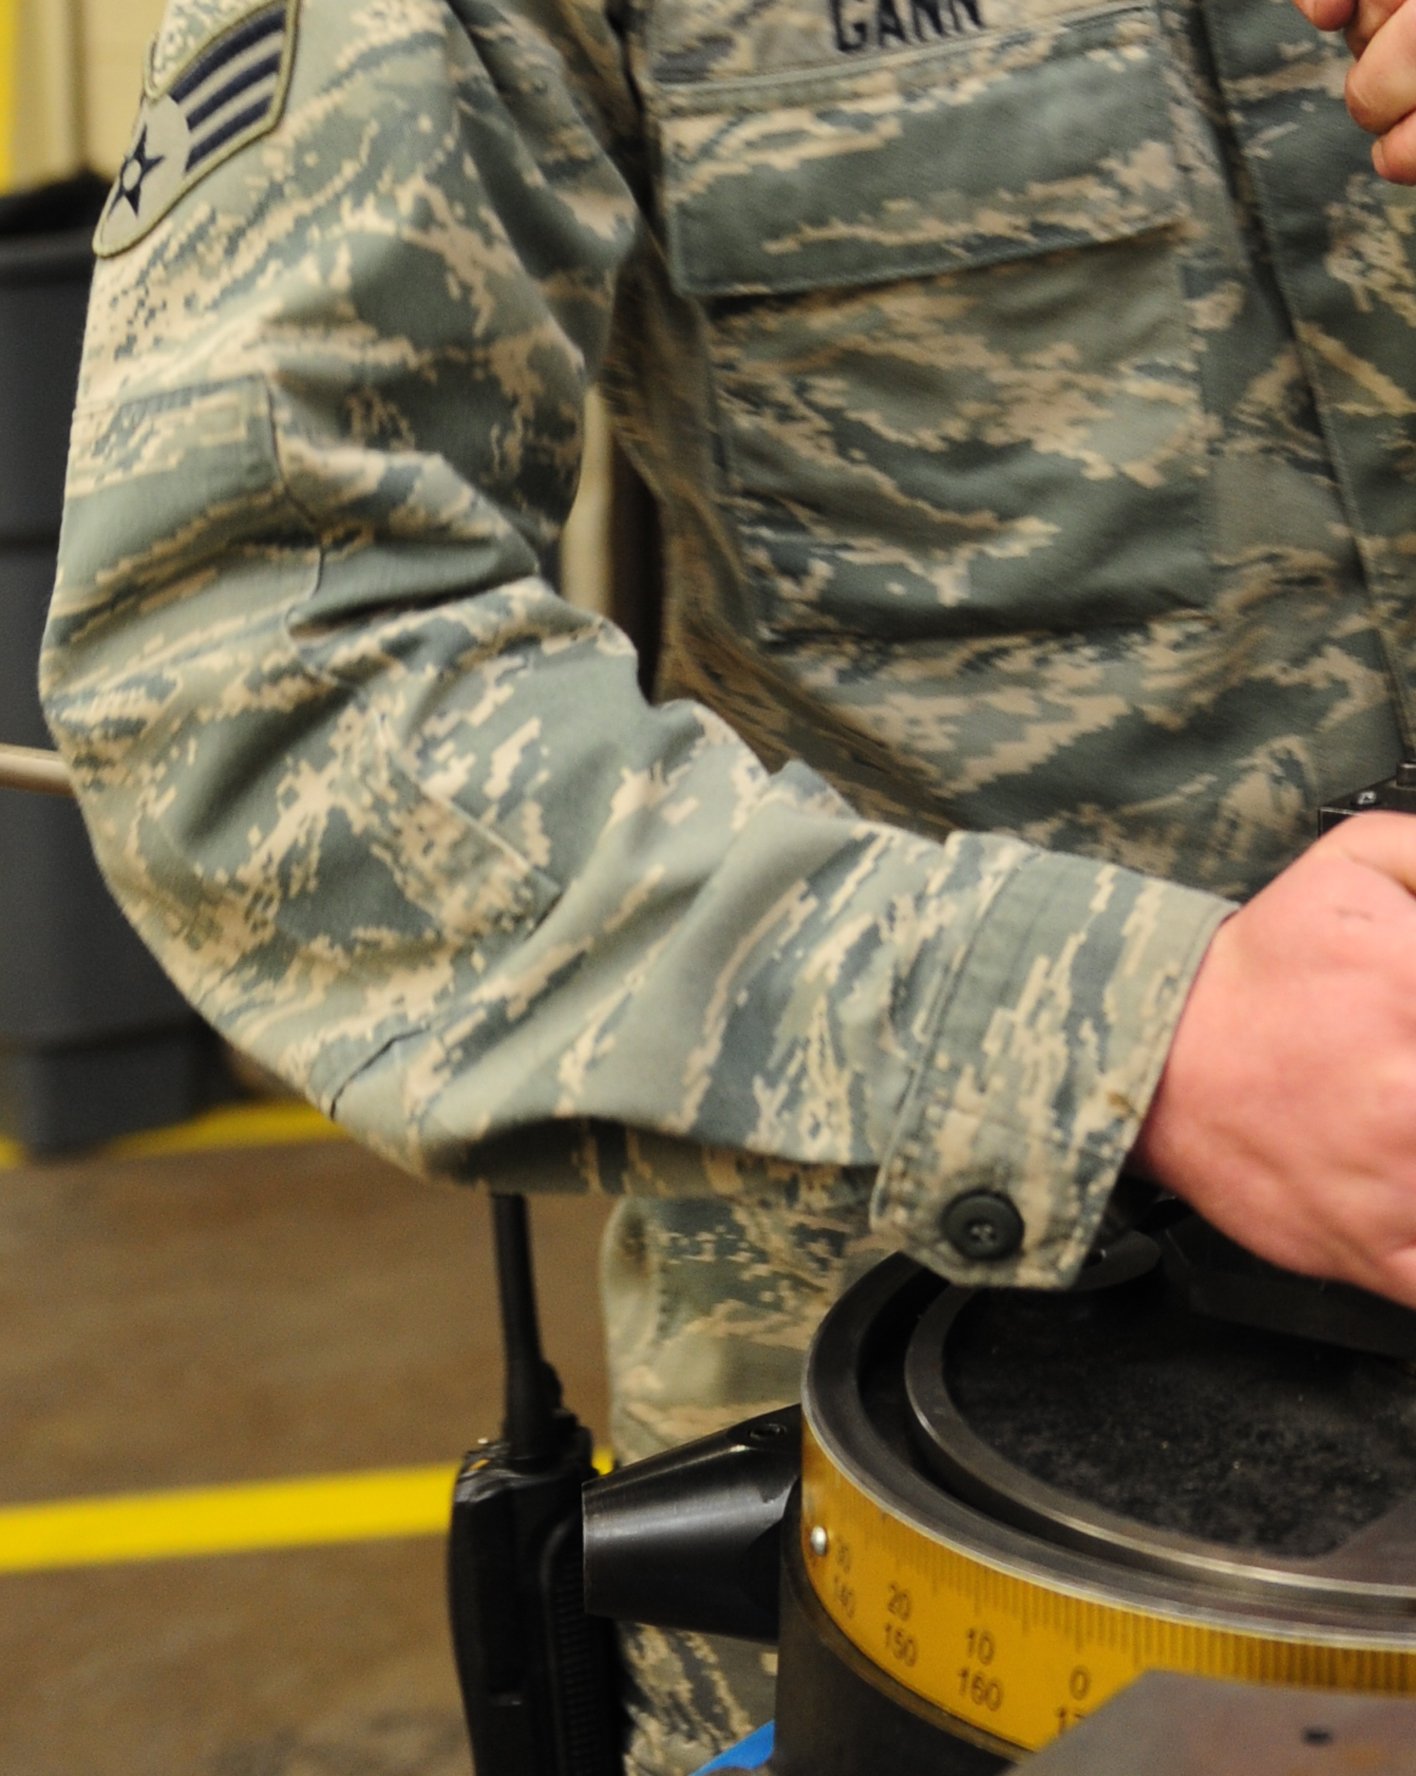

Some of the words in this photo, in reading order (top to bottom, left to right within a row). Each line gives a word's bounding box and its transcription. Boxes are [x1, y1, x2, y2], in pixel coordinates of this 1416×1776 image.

[885, 1622, 919, 1667] 150
[957, 1667, 1003, 1713] 160
[887, 1581, 914, 1622] 20
[966, 1626, 996, 1667] 10
[1069, 1665, 1092, 1701] 0
